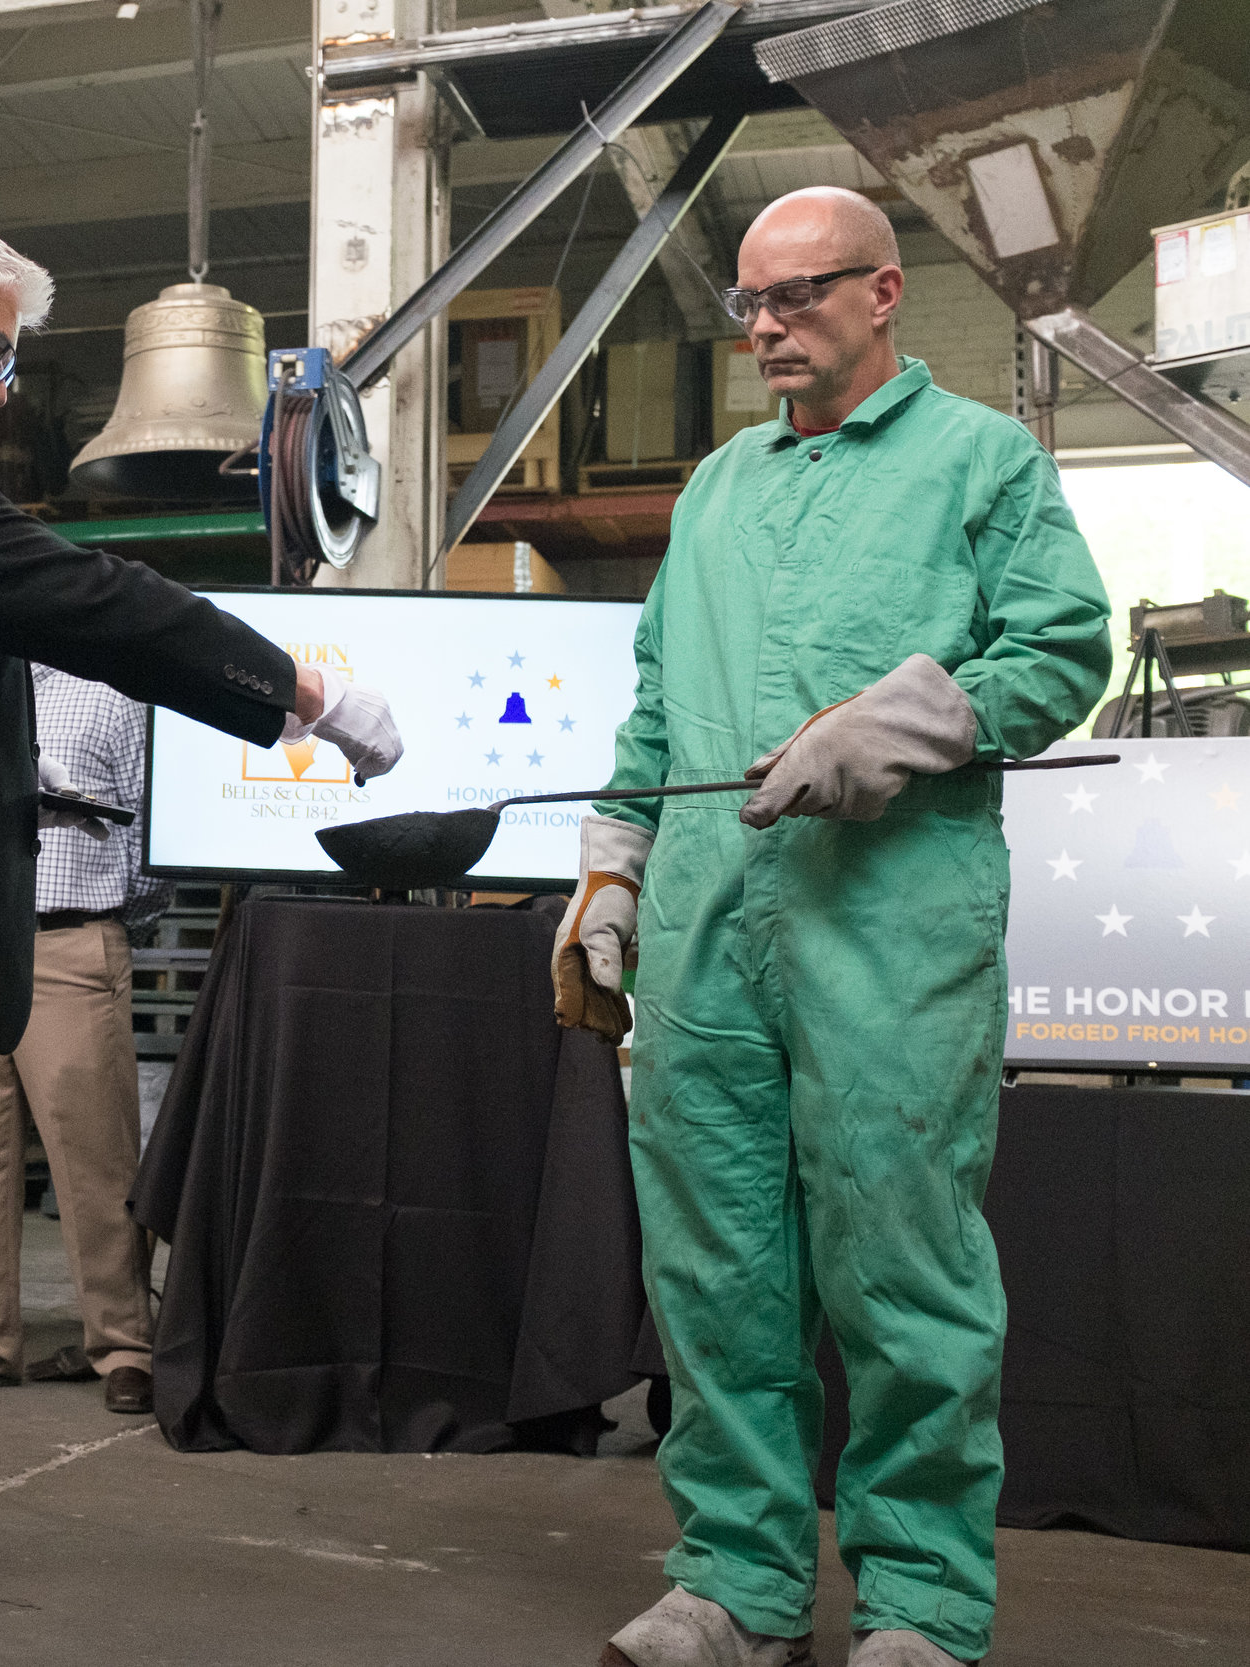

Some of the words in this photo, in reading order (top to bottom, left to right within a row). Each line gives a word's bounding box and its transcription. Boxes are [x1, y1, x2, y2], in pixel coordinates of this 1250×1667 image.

[222, 783, 270, 800] BELLS
[273, 786, 291, 800] &
[295, 784, 372, 803] CLOCKS
[250, 803, 300, 819] SINCE
[306, 805, 339, 820] 1842
[1066, 987, 1229, 1018] HONOR
[1016, 1022, 1119, 1041] FORGED
[1127, 1024, 1200, 1043] FROM
